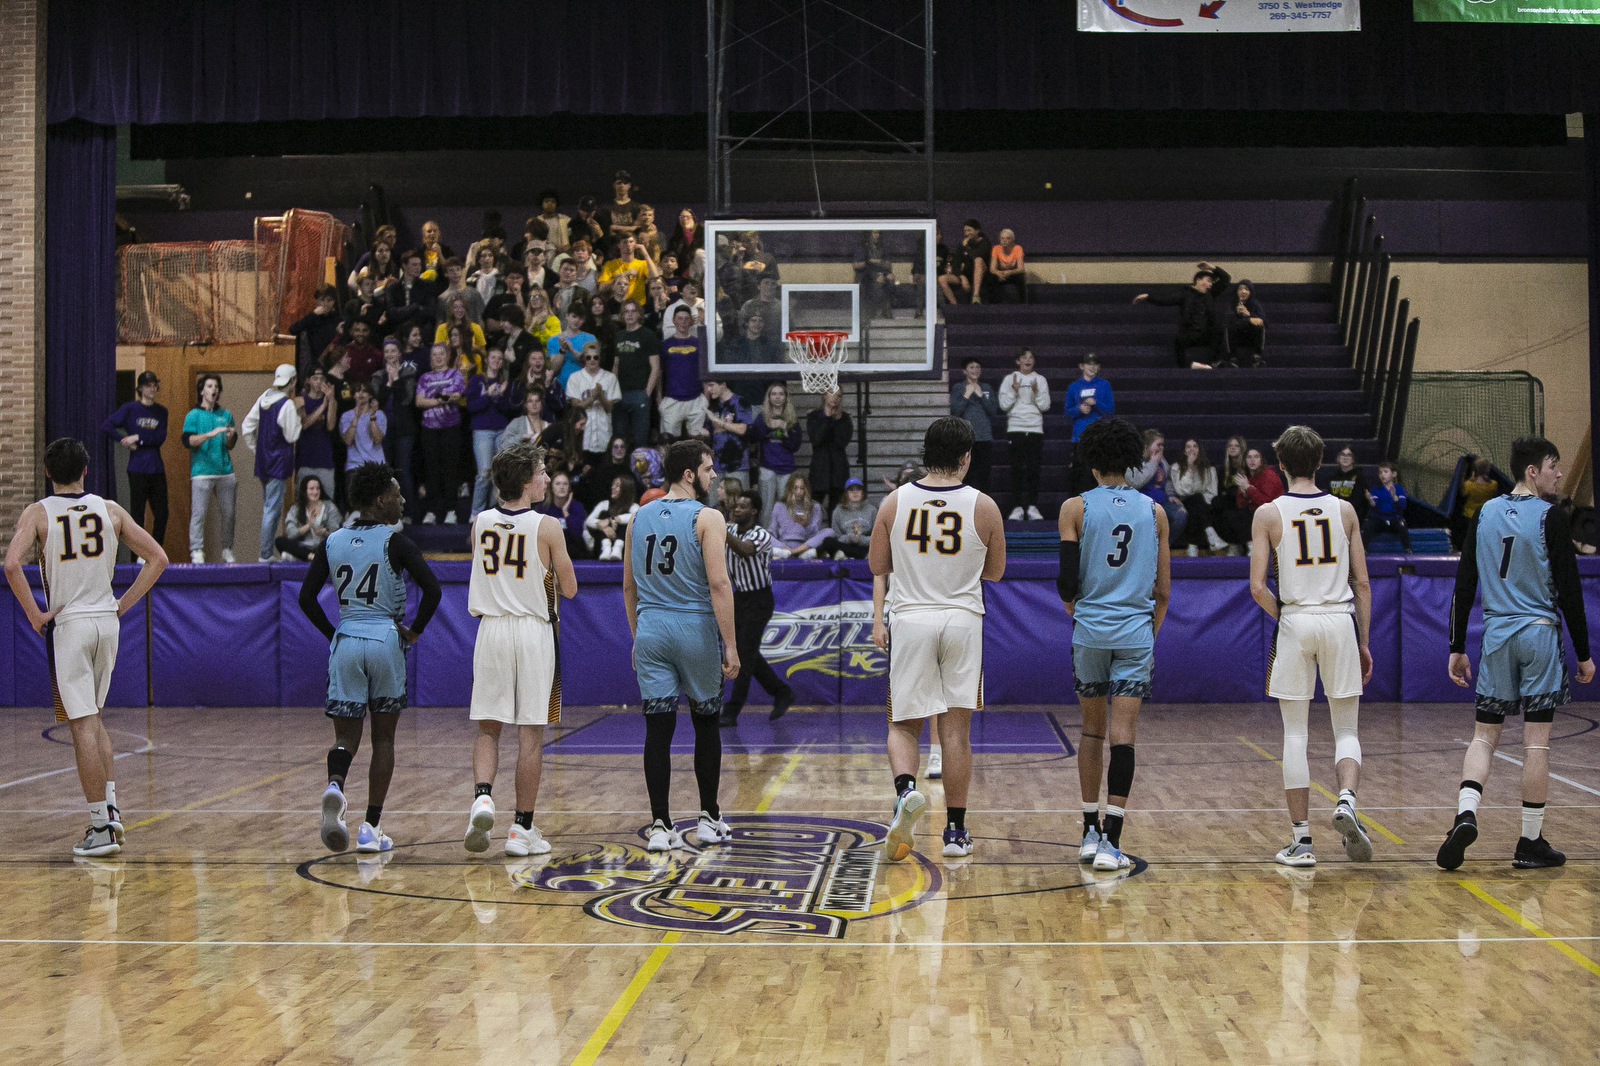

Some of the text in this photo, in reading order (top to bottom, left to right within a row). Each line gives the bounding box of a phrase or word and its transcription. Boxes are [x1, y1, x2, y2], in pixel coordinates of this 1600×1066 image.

[1258, 1, 1342, 10] 3750 S. Westnedge
[1269, 11, 1332, 20] 269-345-7757
[56, 512, 104, 563] 13
[480, 529, 527, 579] 34
[645, 533, 678, 576] 13
[905, 508, 963, 556] 43
[1106, 523, 1134, 568] 3
[1291, 518, 1337, 567] 11
[1499, 534, 1516, 580] 1
[336, 562, 379, 606] 24
[809, 611, 869, 621] KALAMAZOO
